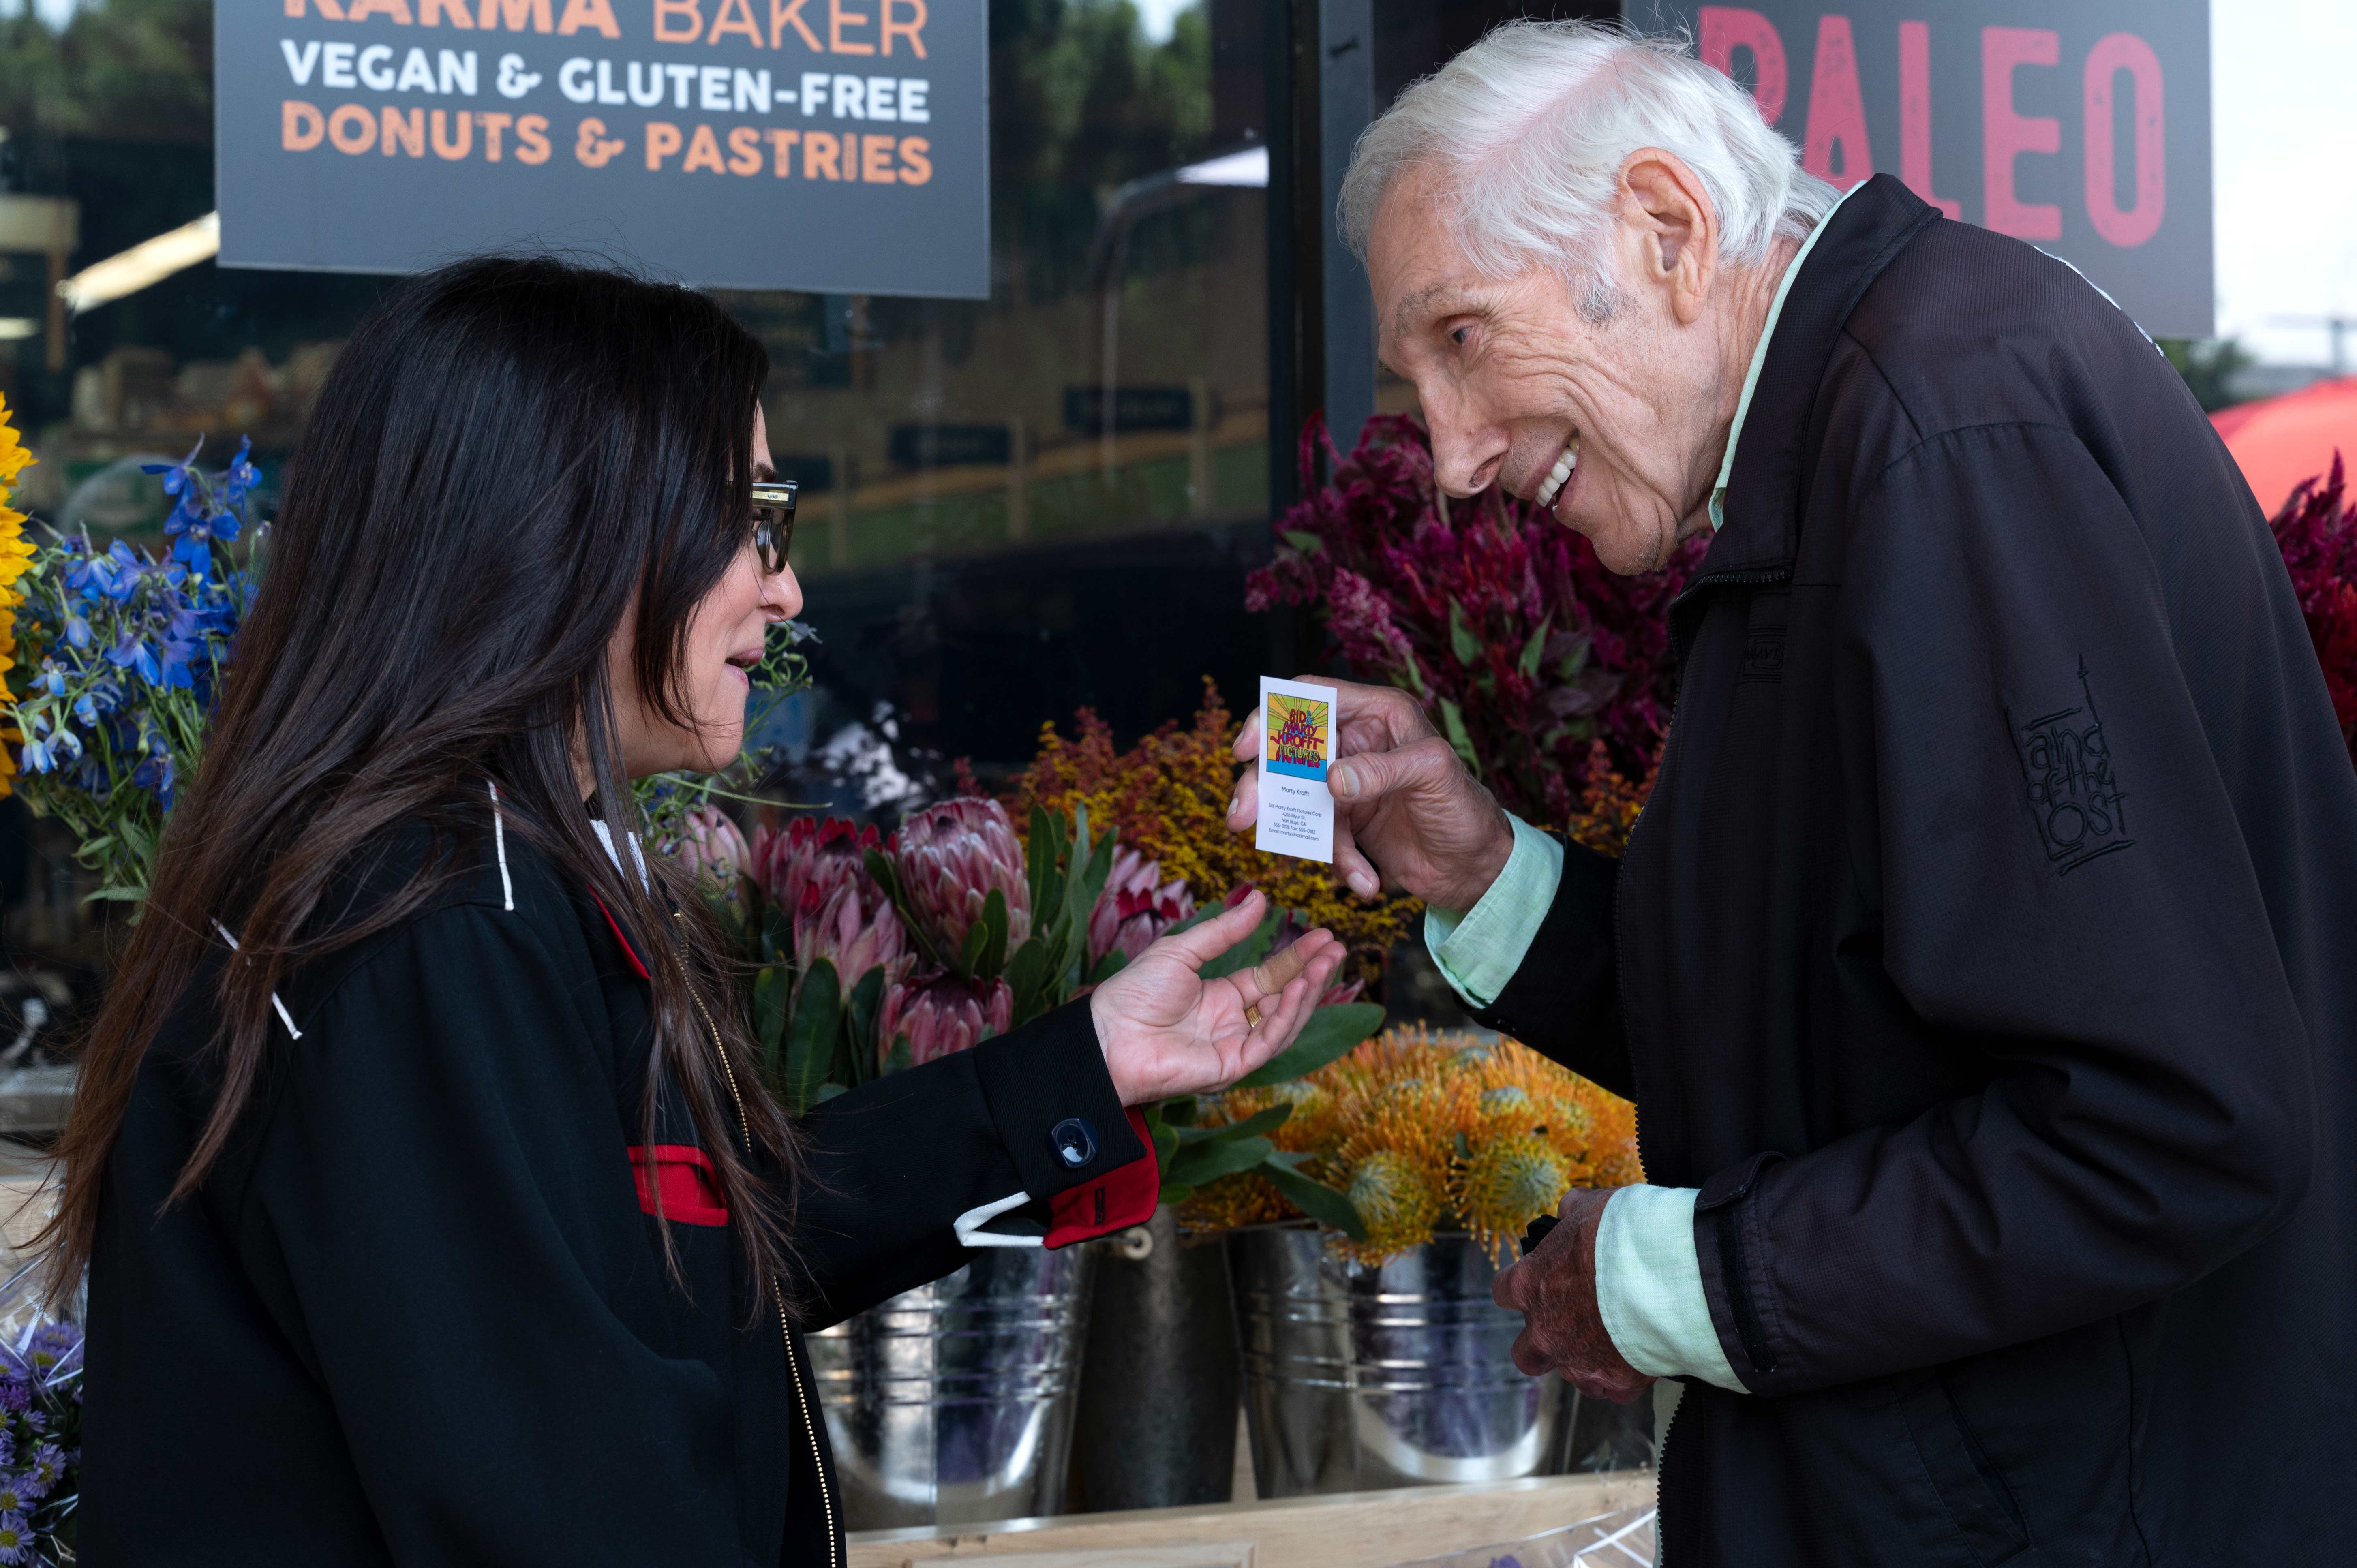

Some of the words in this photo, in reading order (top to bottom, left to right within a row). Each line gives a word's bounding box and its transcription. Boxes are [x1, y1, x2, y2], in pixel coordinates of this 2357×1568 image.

[653, 0, 929, 60] BAKER
[280, 39, 479, 97] VEGAN
[495, 52, 543, 100] &
[557, 56, 931, 123] GLUTEN-FREE
[281, 99, 553, 166] DONUTS
[574, 116, 626, 169] &
[644, 121, 933, 186] PASTRIES
[1289, 708, 1306, 723] SID
[1282, 721, 1318, 737] MARTY
[1270, 731, 1325, 750] KROFFT
[1278, 745, 1320, 764] PICTURES
[1282, 786, 1296, 795] Marty
[1296, 789, 1310, 797] Krofft
